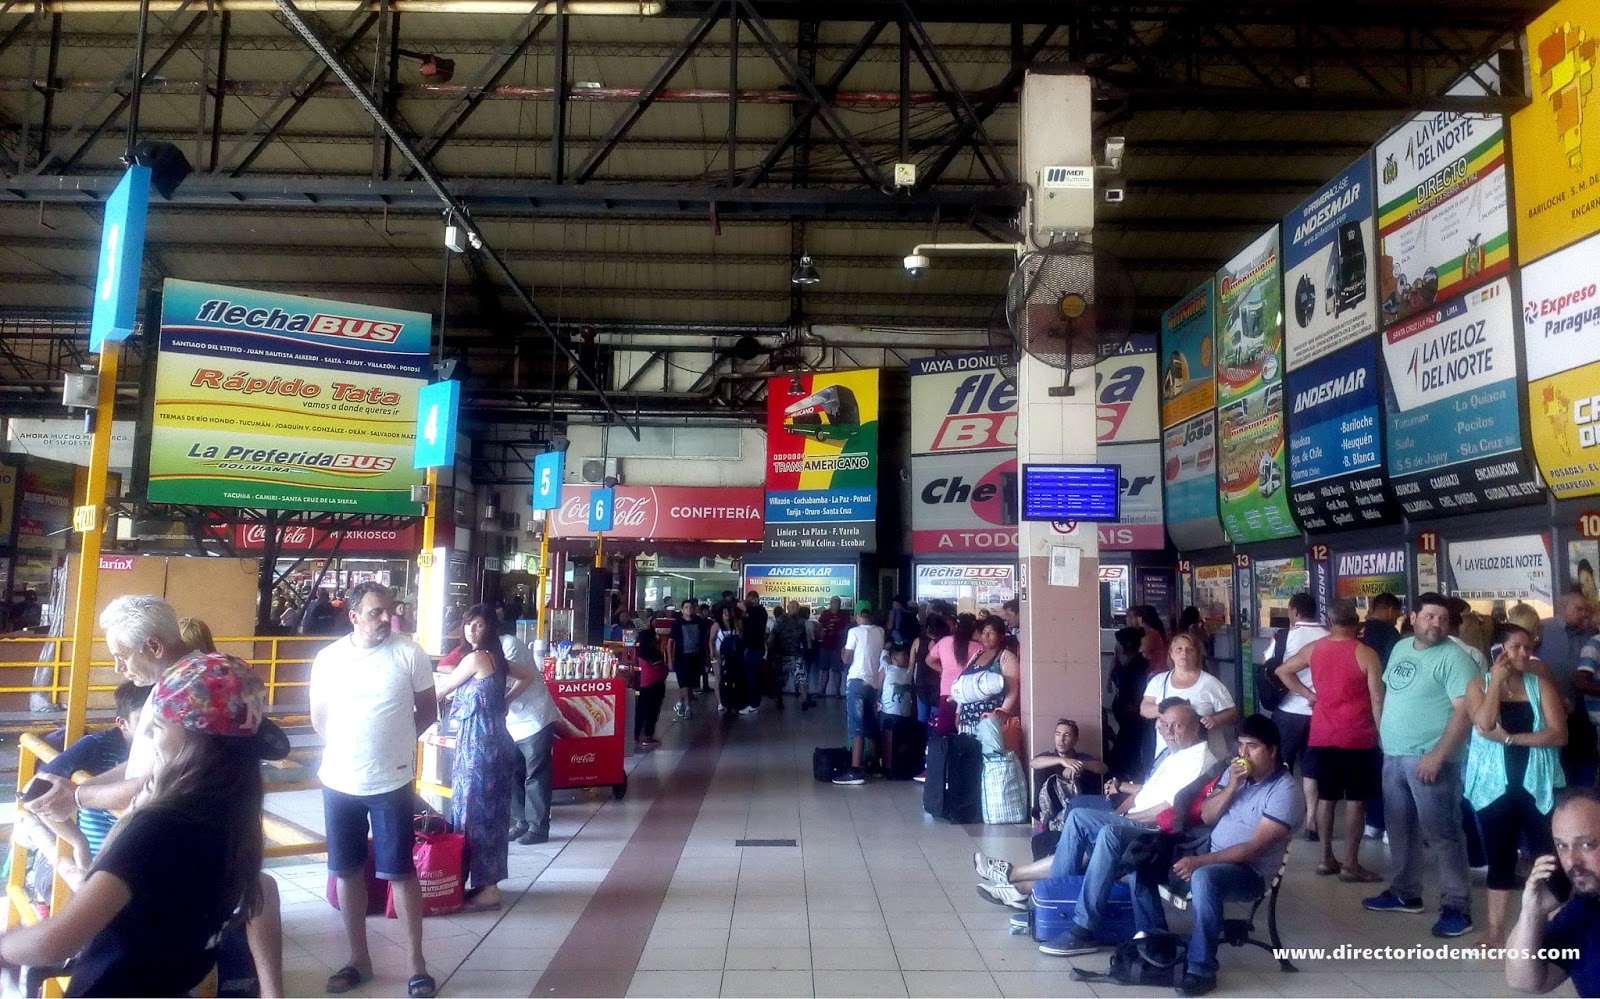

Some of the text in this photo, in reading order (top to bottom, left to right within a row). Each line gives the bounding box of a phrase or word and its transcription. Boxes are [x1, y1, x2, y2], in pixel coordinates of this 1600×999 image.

[1417, 112, 1460, 148] LA VELO
[1418, 116, 1473, 170] DEL NORTE
[1417, 157, 1468, 203] DIRECTO
[1528, 191, 1565, 218] BARILOCHE
[1589, 174, 1599, 186] DE
[1293, 183, 1360, 244] ANDESMAR
[1304, 213, 1347, 246] www.andesmar.com
[1540, 284, 1596, 317] Expreso
[1393, 329, 1405, 339] SANTA
[1406, 323, 1417, 333] CRUZ
[1426, 316, 1435, 326] PAZ
[1447, 305, 1458, 316] LIMA
[1423, 320, 1486, 364] LA VELOZ
[172, 340, 206, 349] SANTIAGO
[220, 345, 242, 353] ESTERO
[247, 348, 264, 356] JUAN
[265, 351, 293, 359] BAUTISTA
[294, 354, 319, 362] ALBERDI
[368, 362, 396, 370] VILLAZÓN
[921, 358, 954, 372] VAYA
[1422, 348, 1493, 392] DEL NORTE
[190, 368, 400, 406] Rápido Tata
[1294, 368, 1366, 414] ANDESMAR
[303, 402, 329, 410] vamos
[339, 402, 364, 412] donde
[365, 407, 392, 416] queres
[1456, 391, 1506, 412] La Quiaca
[312, 426, 344, 434] GONZÁLEZ
[424, 404, 438, 445] 4
[1343, 415, 1372, 433] Bariloche
[1457, 416, 1493, 434] Pocitos
[1291, 436, 1310, 449] Mendoza
[1343, 433, 1372, 450] Neuquén
[1479, 438, 1502, 450] Cruz
[188, 443, 218, 458] La
[1302, 452, 1308, 461] de
[1310, 447, 1322, 459] Chile
[218, 463, 290, 473] BOLIVIANA
[773, 457, 869, 473] TRANSAMERICANO
[1344, 452, 1375, 467] B. Blanca
[1475, 462, 1519, 481] ENCARNACION
[1550, 463, 1599, 478] POSADAS EL
[540, 468, 550, 495] 5
[1430, 474, 1460, 489] CAAGUAZU
[769, 497, 790, 505] Villazón
[794, 496, 828, 504] Cochabamba
[853, 494, 871, 502] Potosí
[595, 500, 603, 520] 6
[670, 505, 760, 519] CONFITERÍA
[786, 509, 801, 517] Tarija
[777, 528, 797, 536] Liniers
[802, 528, 810, 536] La
[839, 527, 859, 535] Varela
[1580, 515, 1600, 536] 10
[801, 539, 815, 547] Villa
[816, 539, 836, 547] Celina
[938, 534, 953, 547] A
[1422, 533, 1435, 550] 11
[1236, 554, 1249, 566] 13
[1312, 546, 1327, 560] 12
[1179, 560, 1190, 571] 14
[1339, 551, 1404, 575] ANDESMAR
[1465, 554, 1542, 571] LA VELOZ DEL NORTE
[768, 568, 831, 576] ANDESMAR
[559, 682, 612, 693] PANCHOS
